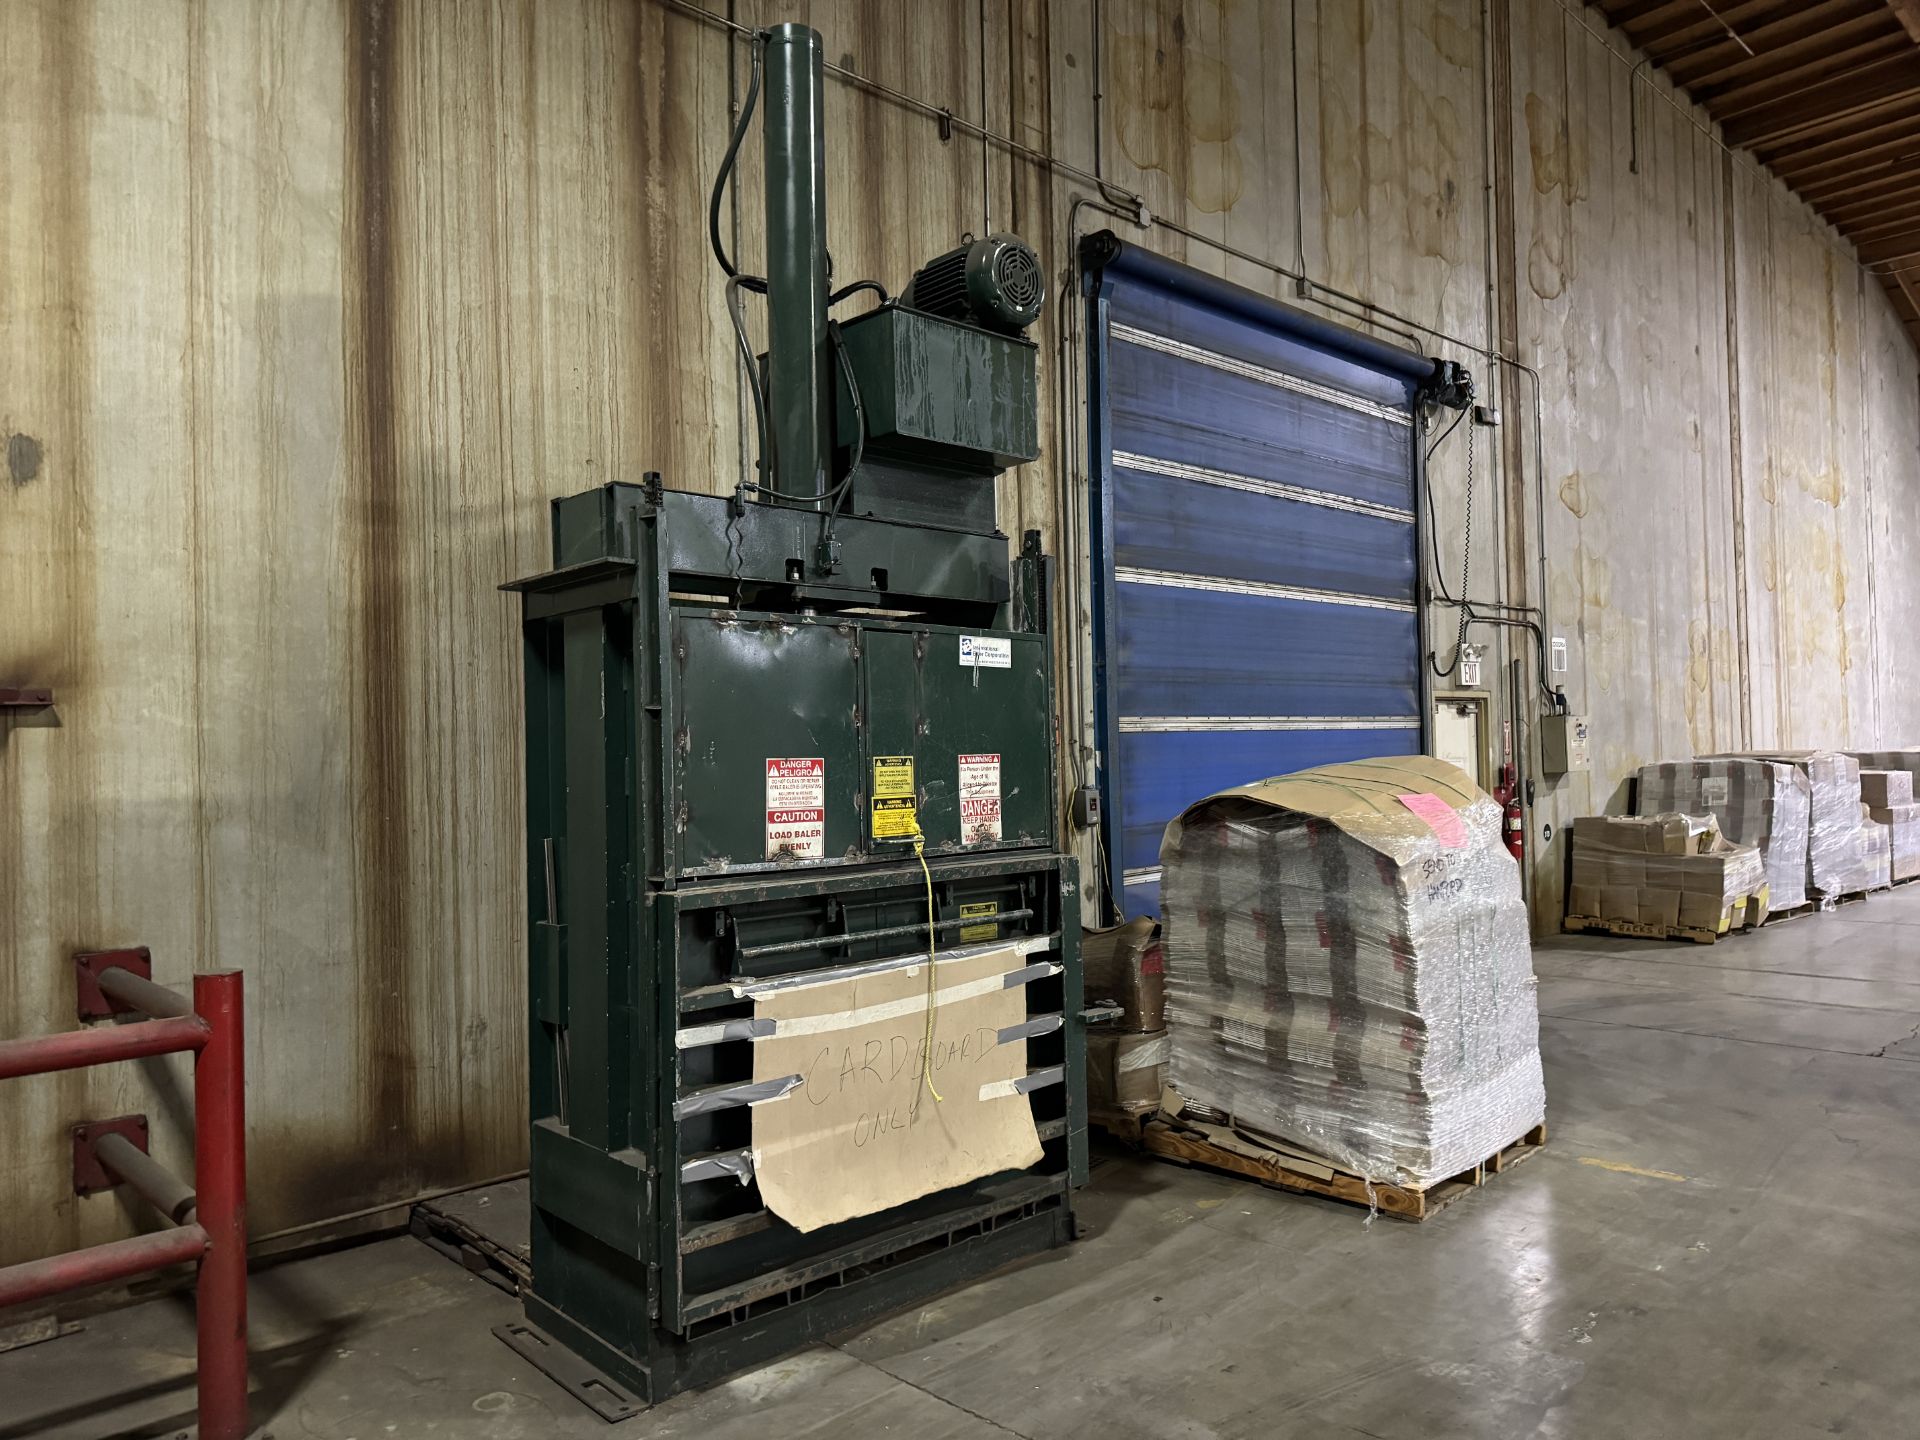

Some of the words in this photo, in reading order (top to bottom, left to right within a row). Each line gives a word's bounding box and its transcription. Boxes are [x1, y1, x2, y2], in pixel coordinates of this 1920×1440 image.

[1464, 664, 1476, 684] EXIT
[962, 799, 1000, 816] DANGER
[774, 811, 818, 822] CAUTION
[979, 815, 999, 823] HANDS
[770, 831, 793, 840] LOAD
[795, 830, 821, 838] BALER
[780, 842, 811, 851] EVENLY
[1446, 853, 1456, 866] TO
[1619, 924, 1652, 934] RACKS
[806, 1028, 999, 1106] CARDBOARD
[854, 1096, 920, 1147] ONLY
